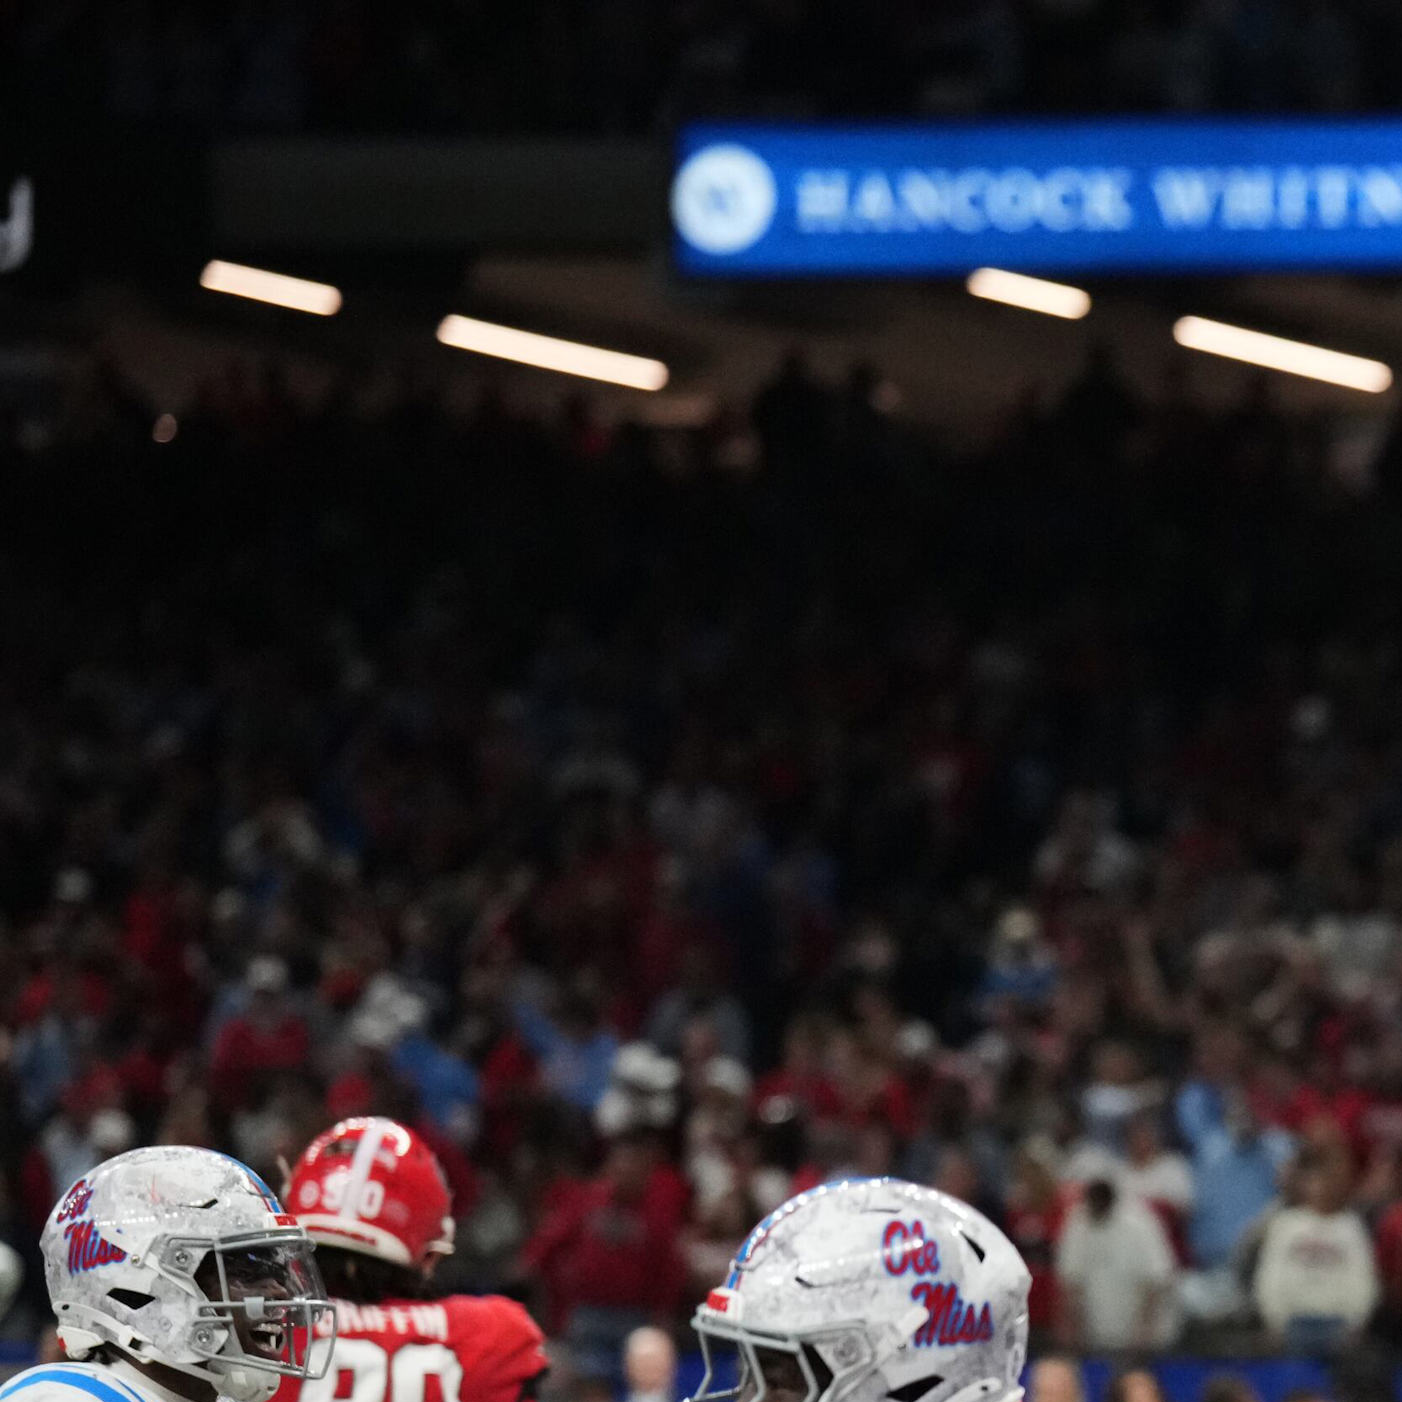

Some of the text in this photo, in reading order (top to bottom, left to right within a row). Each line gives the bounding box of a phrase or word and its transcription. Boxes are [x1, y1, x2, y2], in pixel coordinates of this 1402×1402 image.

[796, 167, 1134, 233] HANCOCK
[883, 1220, 940, 1277] Ole
[911, 1281, 994, 1347] Miss
